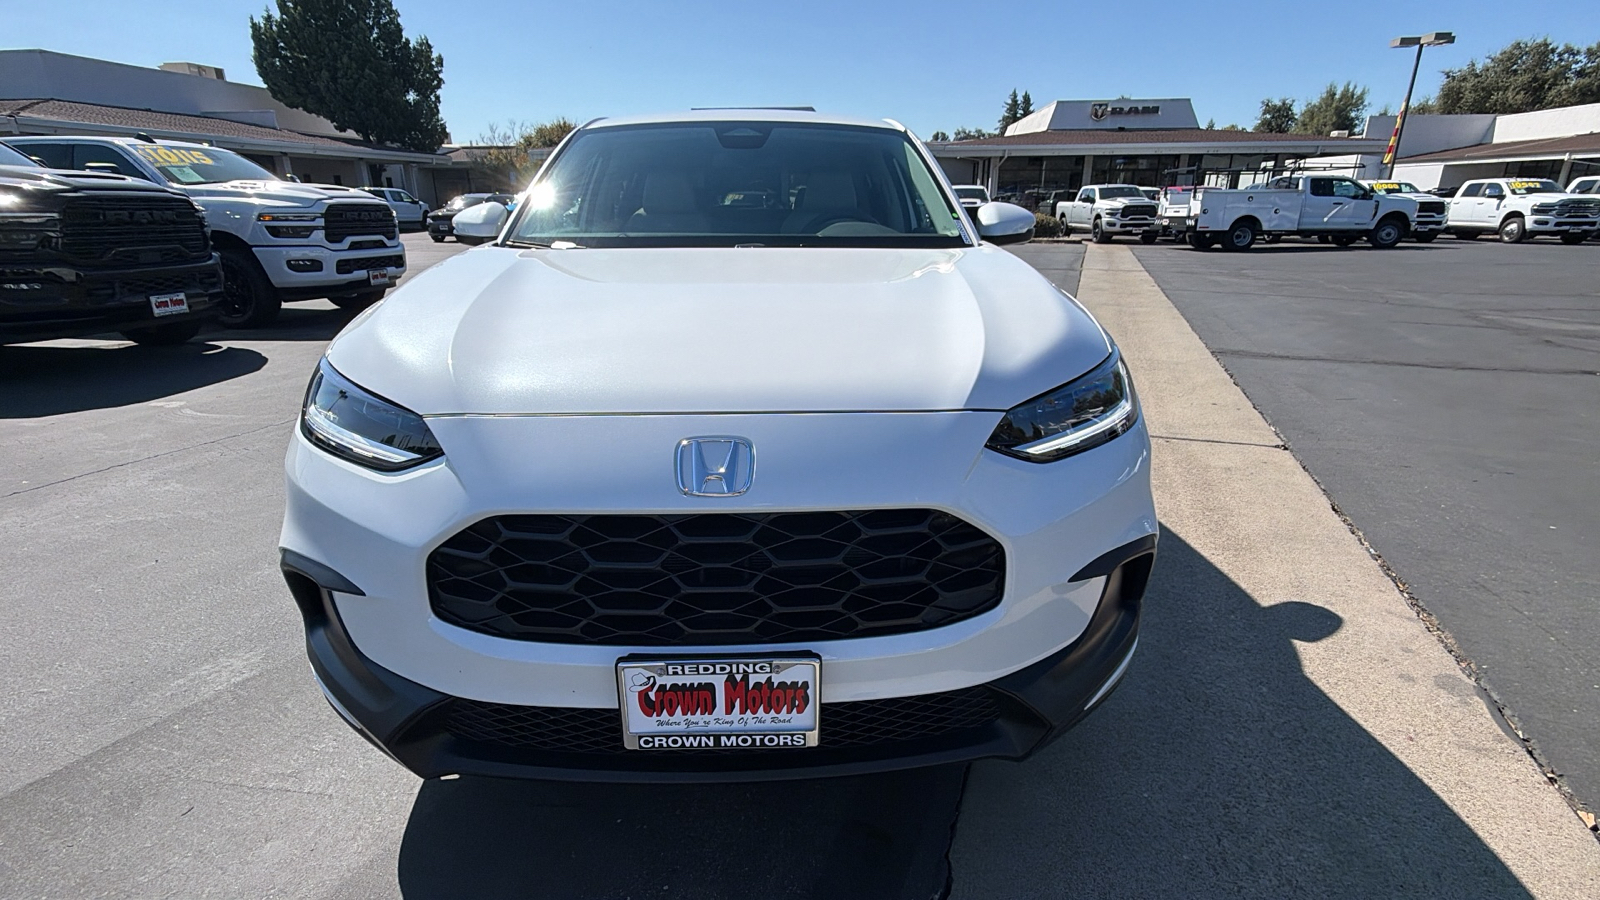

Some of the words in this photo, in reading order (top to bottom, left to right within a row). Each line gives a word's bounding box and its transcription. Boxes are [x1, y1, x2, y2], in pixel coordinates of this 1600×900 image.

[1110, 106, 1160, 115] RAM
[667, 663, 771, 675] REDDING
[637, 677, 717, 718] Crown
[723, 674, 810, 716] Motors
[655, 718, 682, 727] Where
[683, 717, 711, 729] You're
[713, 717, 735, 727] King
[737, 716, 749, 727] Of
[752, 716, 767, 725] The
[769, 716, 793, 725] Road
[639, 735, 715, 748] CROWN
[720, 734, 806, 747] MOTORS
